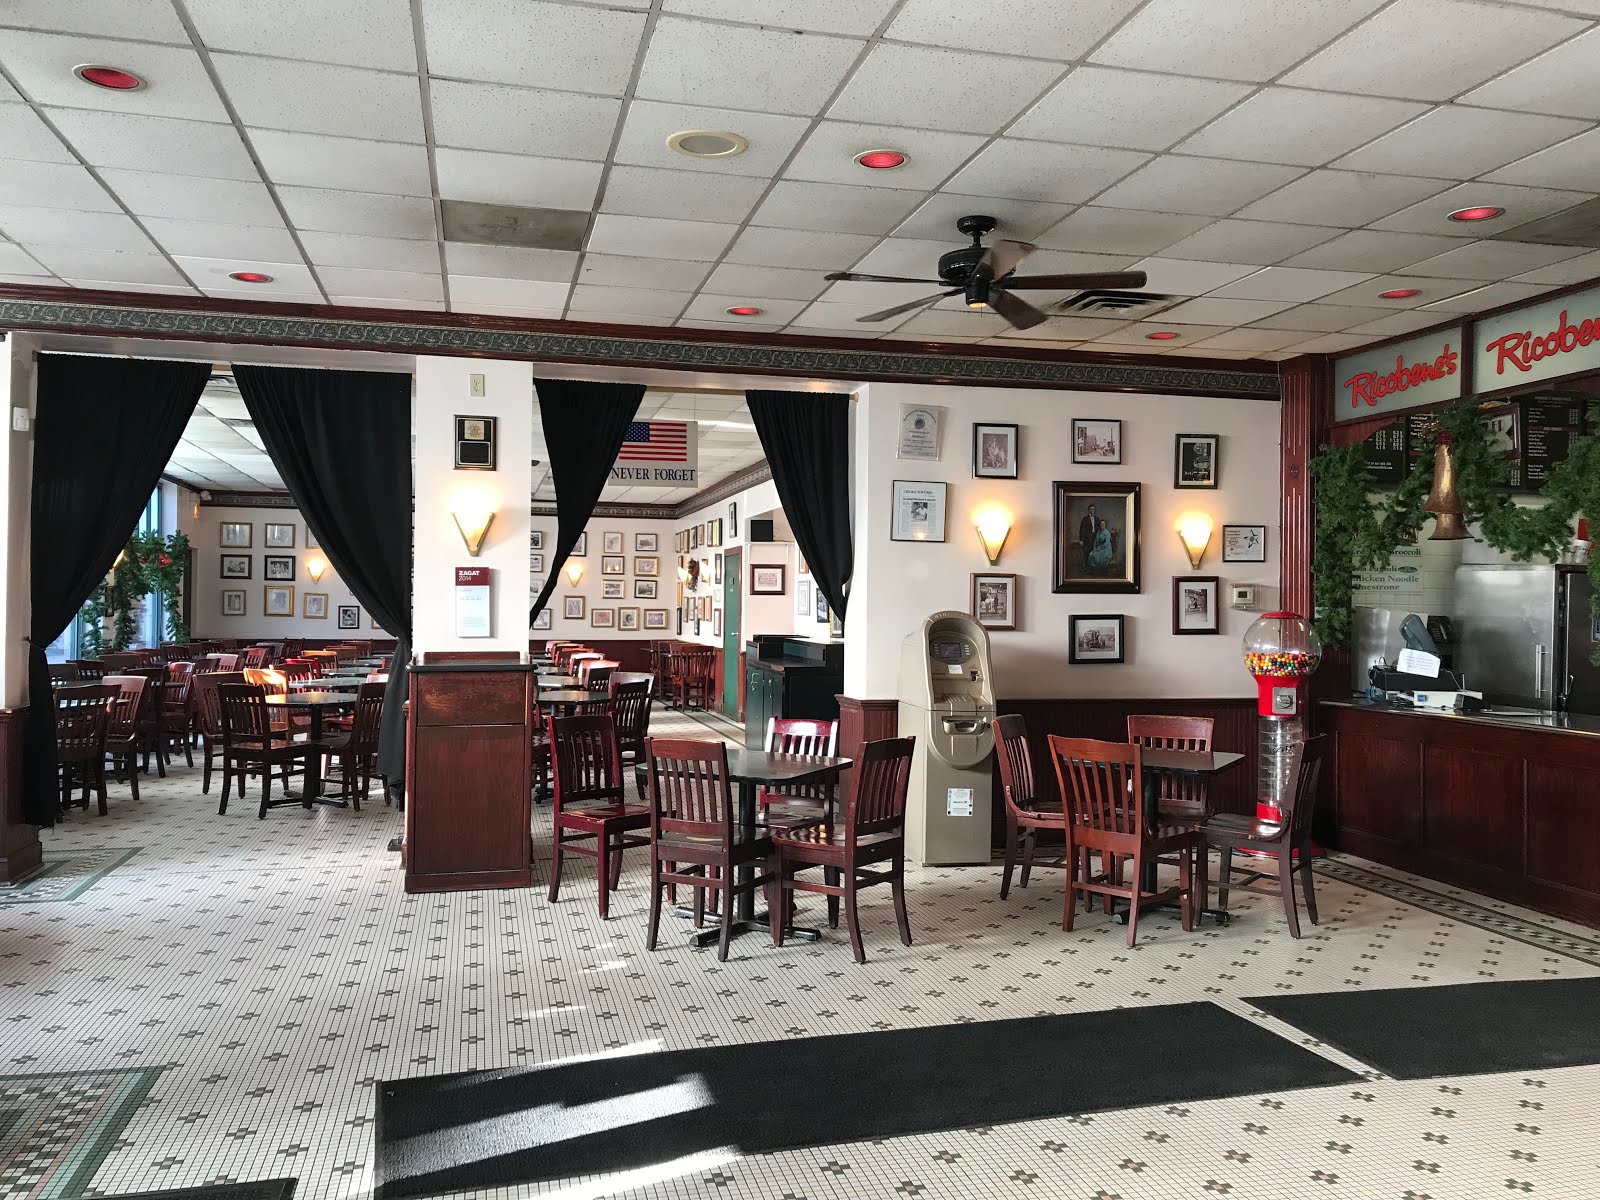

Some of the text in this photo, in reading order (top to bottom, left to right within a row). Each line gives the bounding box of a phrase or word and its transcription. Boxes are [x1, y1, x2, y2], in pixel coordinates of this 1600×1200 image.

[1344, 344, 1458, 408] Ricobene's
[611, 468, 696, 481] NEVER FORGET
[1390, 548, 1422, 556] roccoli
[1388, 575, 1420, 583] Noodle
